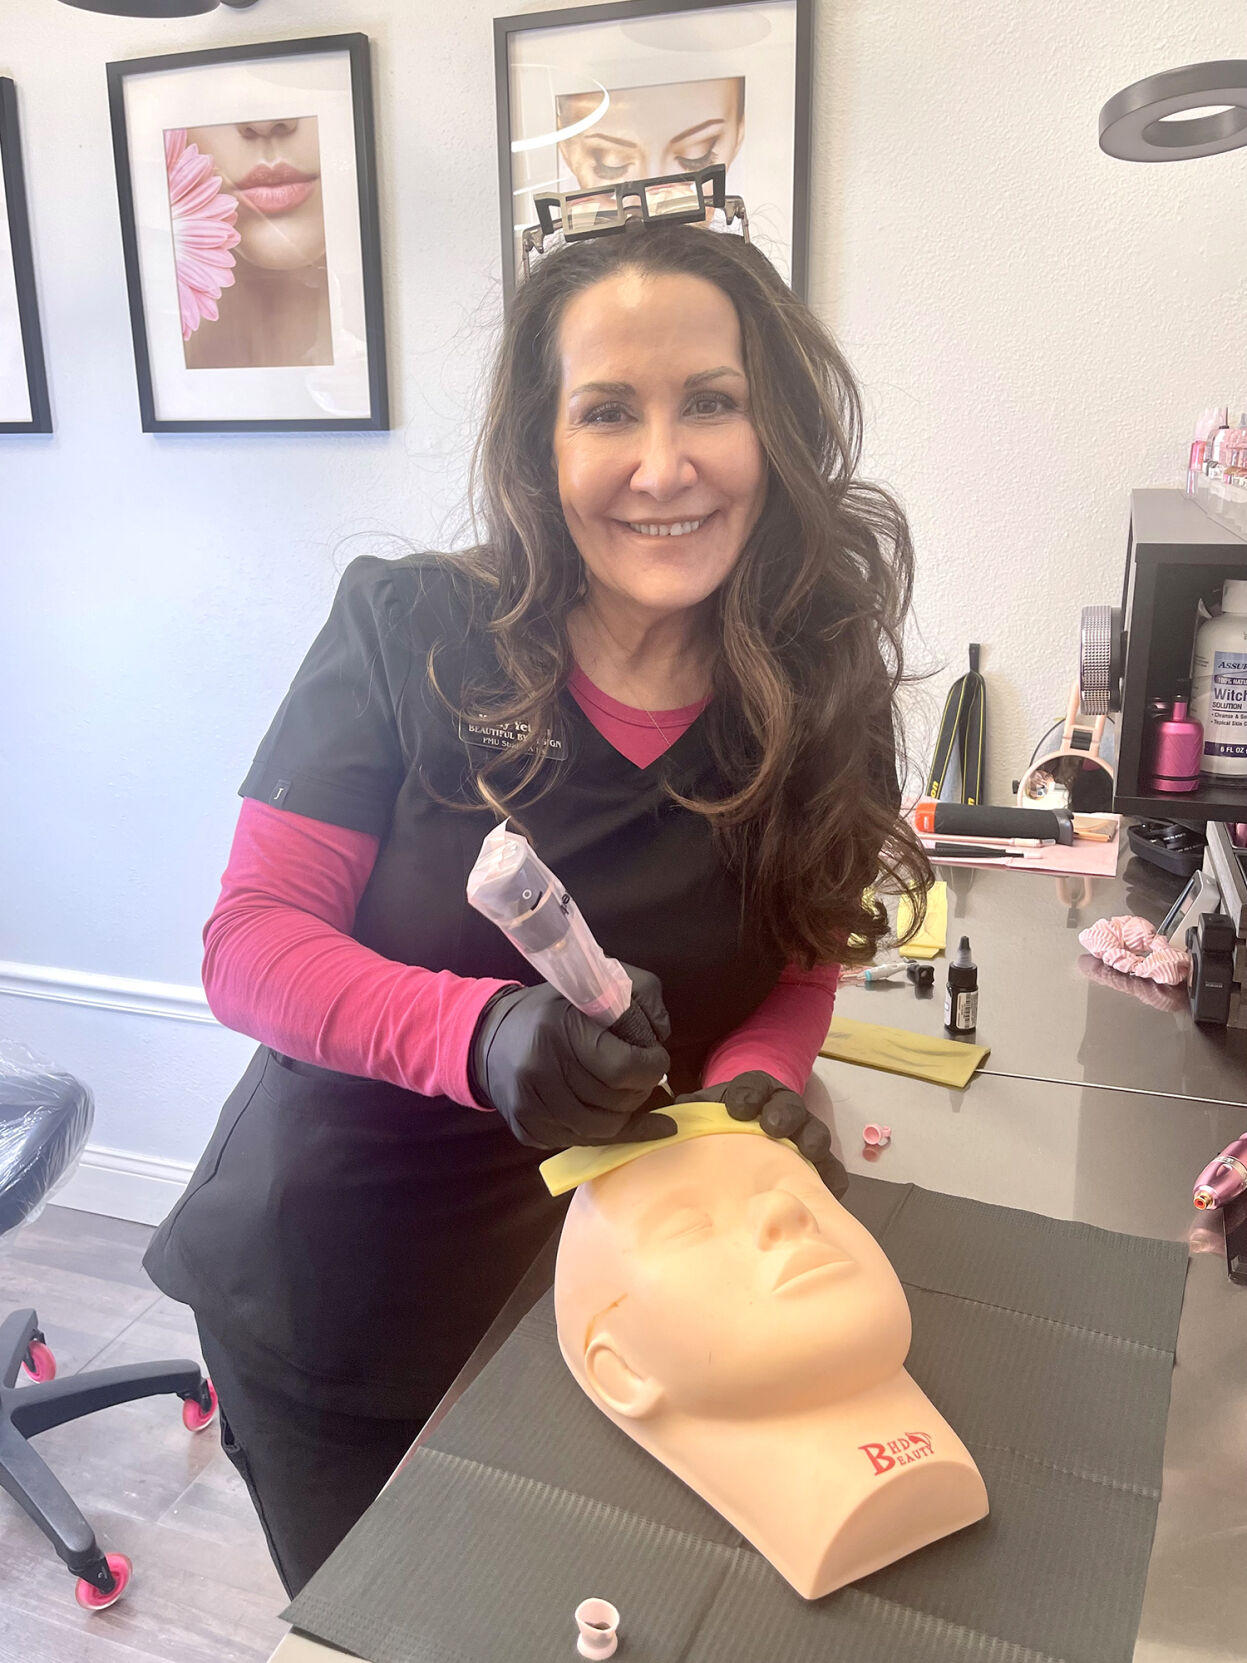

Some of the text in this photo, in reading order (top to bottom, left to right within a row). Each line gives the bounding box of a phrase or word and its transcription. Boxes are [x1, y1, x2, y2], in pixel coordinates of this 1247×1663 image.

[1212, 702, 1243, 710] SOLUTION
[468, 724, 528, 742] BEAUTIFUL BY
[482, 737, 500, 746] PMU
